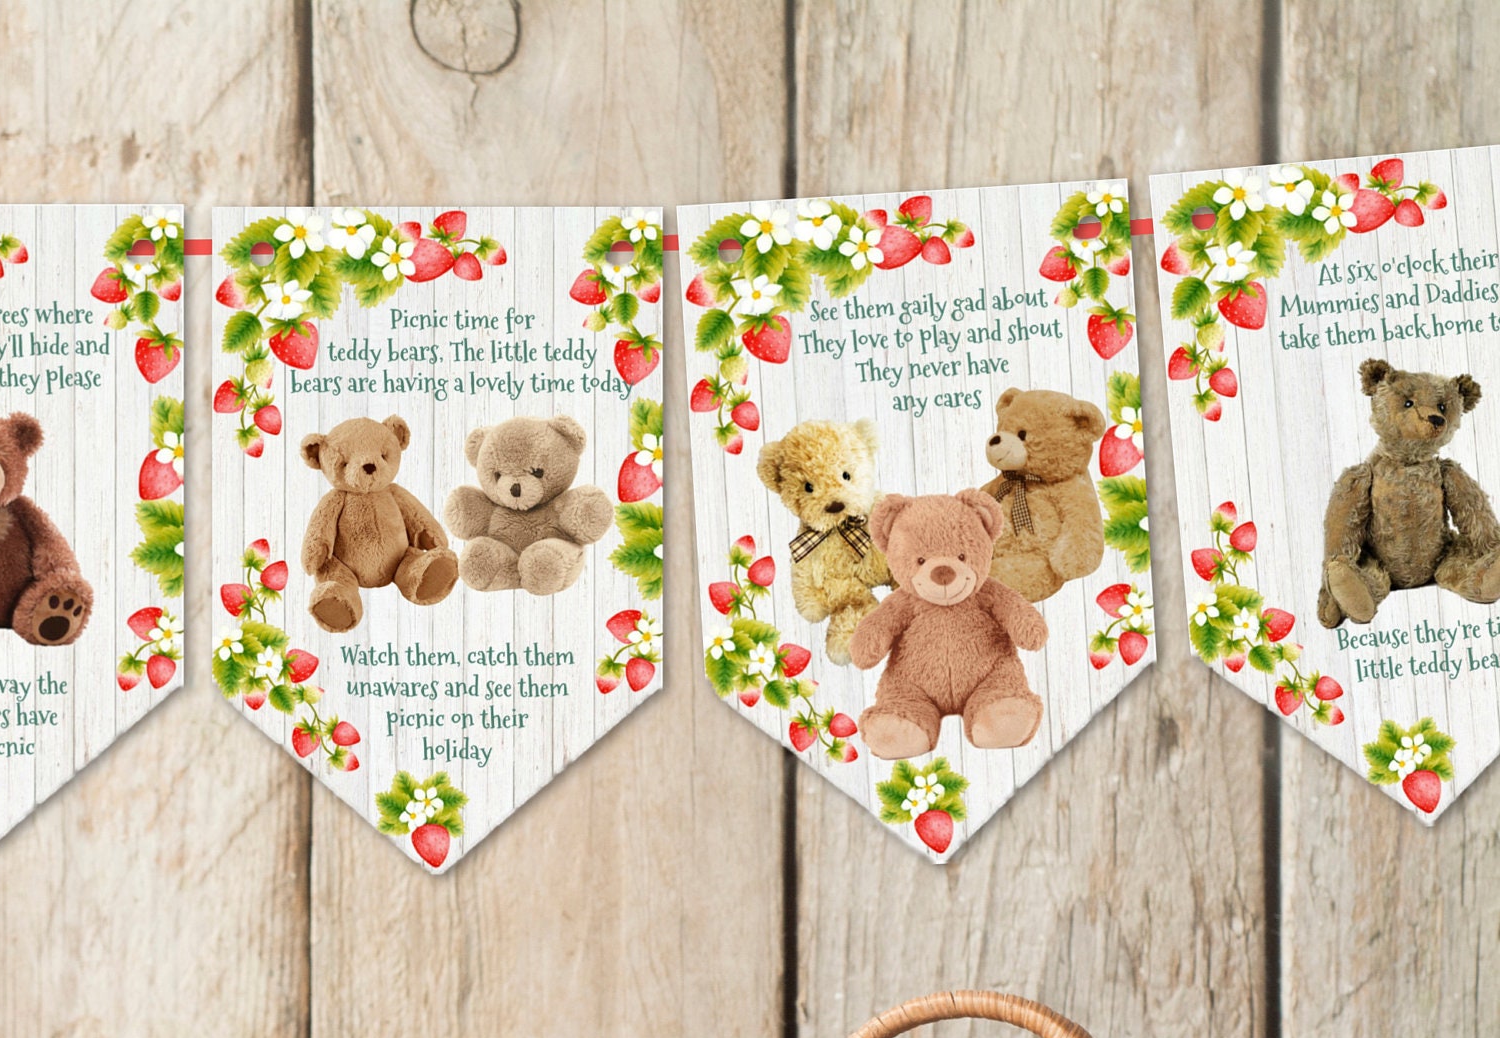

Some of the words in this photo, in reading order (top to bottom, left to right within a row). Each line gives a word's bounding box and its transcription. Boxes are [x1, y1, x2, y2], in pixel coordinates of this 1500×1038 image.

[1318, 262, 1343, 286] At
[1347, 260, 1377, 284] six
[1382, 249, 1451, 278] o'clock
[1450, 248, 1499, 272] their
[35, 301, 93, 325] where
[810, 299, 838, 322] See
[843, 296, 895, 321] them
[898, 293, 947, 326] gaily
[950, 288, 986, 321] gad
[992, 287, 1048, 311] about
[1279, 292, 1380, 317] Mummies
[1386, 283, 1420, 310] and
[1426, 279, 1499, 304] Daddies
[391, 308, 448, 330] Picnic
[454, 310, 498, 330] time
[505, 307, 535, 334] for
[1279, 323, 1320, 350] take
[1325, 322, 1376, 347] them
[1381, 313, 1431, 342] back
[1432, 313, 1483, 337] home
[1489, 312, 1500, 332] t
[30, 332, 69, 356] hide
[74, 332, 110, 356] and
[327, 338, 381, 369] teddy
[388, 338, 444, 364] bears,
[449, 338, 485, 362] The
[490, 340, 537, 363] little
[543, 338, 597, 369] teddy
[798, 330, 846, 360] They
[852, 329, 889, 353] love
[894, 328, 913, 349] to
[920, 324, 961, 354] play
[966, 319, 1001, 344] and
[1007, 317, 1063, 345] shout
[46, 365, 101, 394] please
[290, 370, 342, 396] bears
[348, 377, 377, 393] are
[383, 369, 448, 401] having
[454, 377, 464, 393] a
[470, 371, 524, 400] lovely
[530, 372, 575, 393] time
[581, 369, 633, 400] today
[855, 357, 903, 388] They
[909, 358, 961, 380] never
[967, 352, 1010, 375] have
[892, 393, 928, 418] any
[934, 388, 982, 410] cares
[1336, 627, 1409, 650] Because
[1414, 619, 1481, 650] they're
[340, 642, 399, 667] Watch
[405, 642, 460, 667] them,
[467, 642, 518, 666] catch
[523, 642, 574, 667] them
[1355, 656, 1403, 682] little
[1408, 648, 1462, 679] teddy
[36, 671, 68, 695] the
[347, 679, 439, 700] unawares
[444, 674, 479, 697] and
[485, 680, 512, 700] see
[518, 674, 569, 698] them
[16, 701, 57, 726] have
[386, 707, 444, 738] picnic
[451, 712, 475, 729] on
[480, 706, 528, 729] their
[423, 737, 492, 768] holiday
